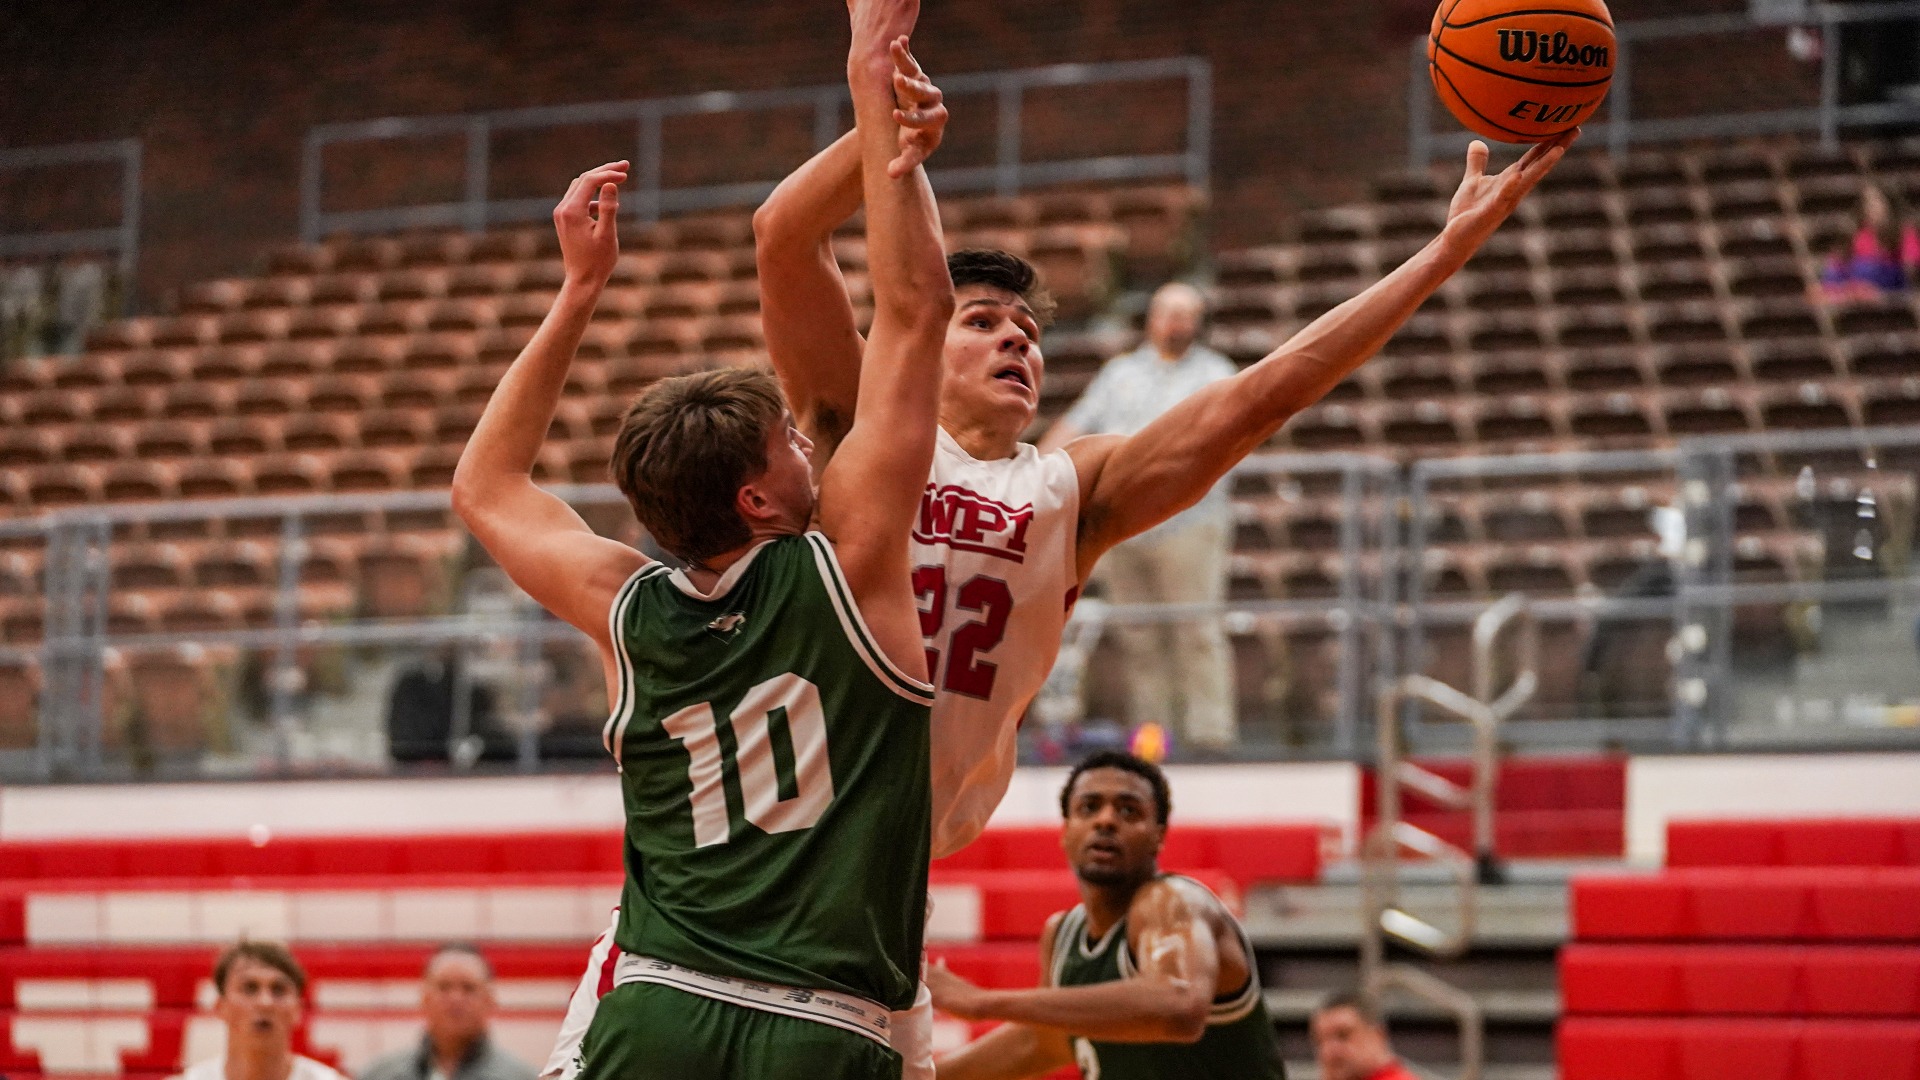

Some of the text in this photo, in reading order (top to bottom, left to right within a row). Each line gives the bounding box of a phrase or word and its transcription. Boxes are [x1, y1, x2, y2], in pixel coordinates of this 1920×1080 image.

[1497, 29, 1609, 68] Wilson
[920, 494, 1034, 551] WPI
[661, 672, 835, 849] 10
